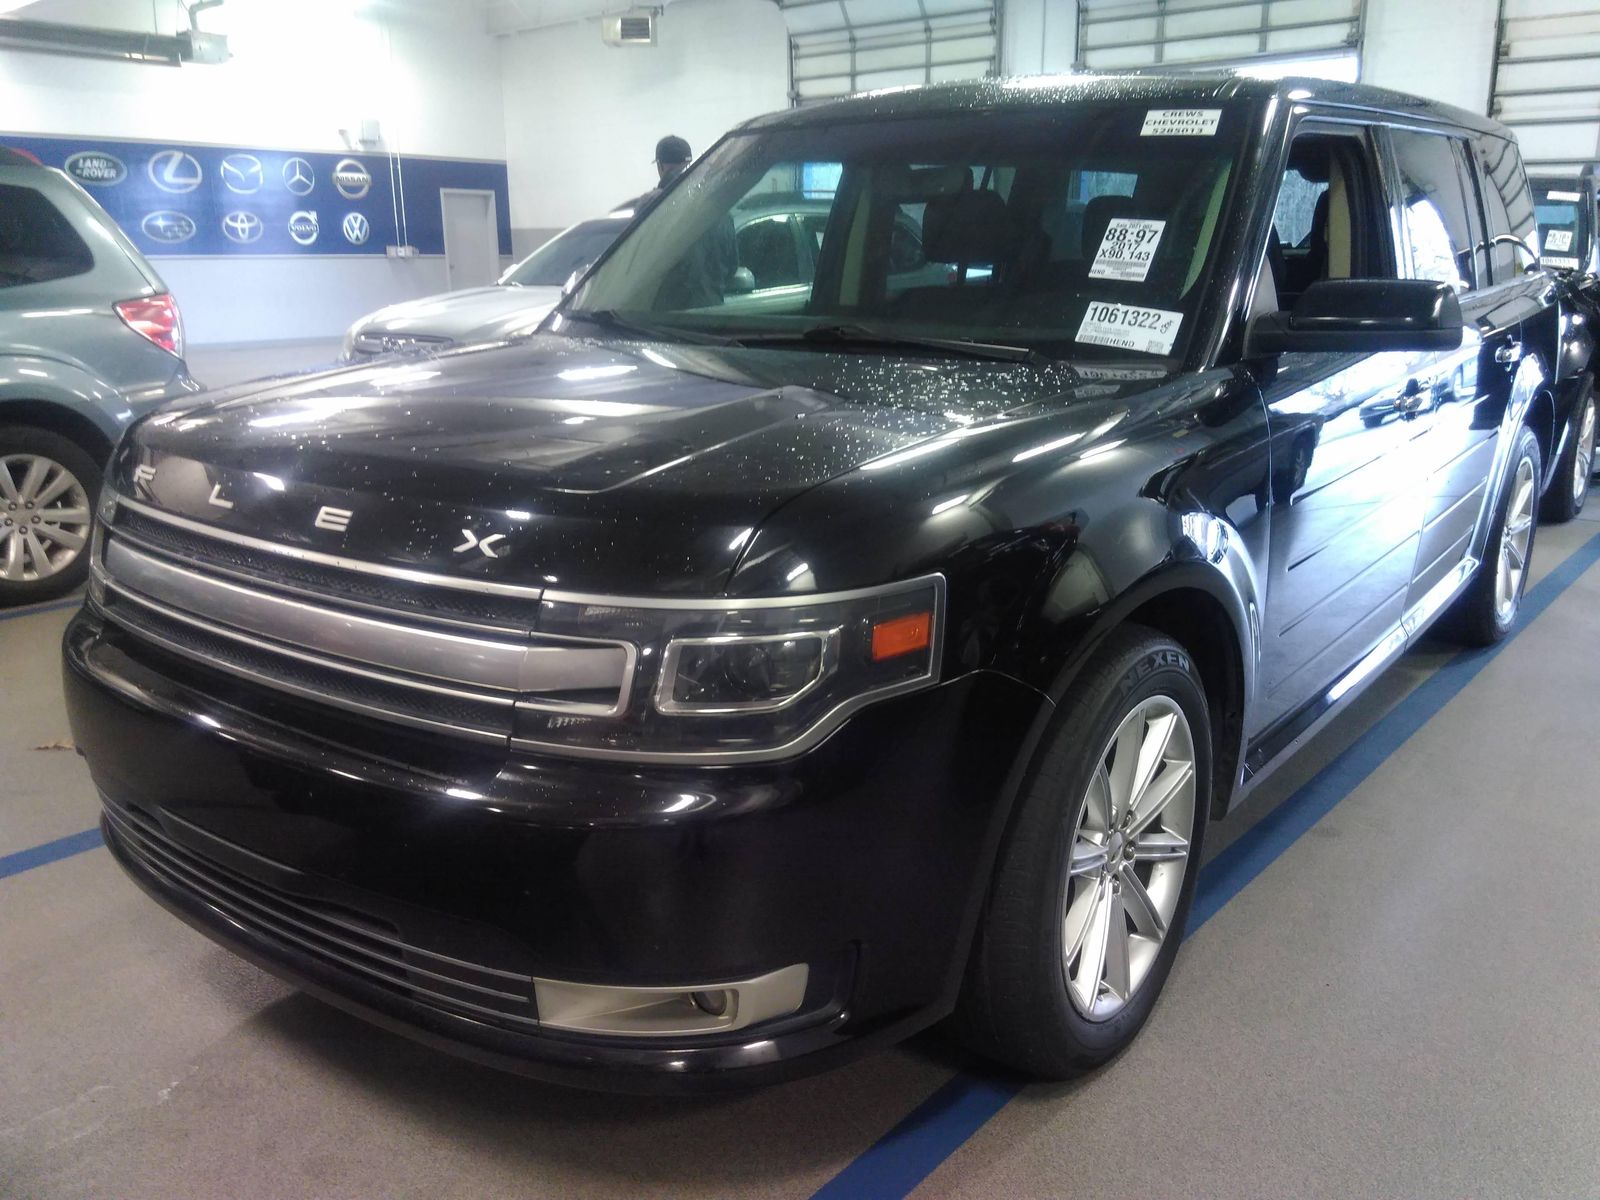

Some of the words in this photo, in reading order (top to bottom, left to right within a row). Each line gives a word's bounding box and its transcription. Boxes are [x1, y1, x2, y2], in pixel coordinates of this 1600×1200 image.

[78, 157, 107, 168] LAND
[82, 167, 117, 179] ROVER
[335, 174, 369, 184] NISSAN
[290, 224, 317, 232] VOLVO
[1110, 240, 1144, 251] 2017
[1089, 305, 1162, 330] 1061322
[134, 463, 506, 559] FLEX
[1120, 650, 1190, 697] NEXEN
